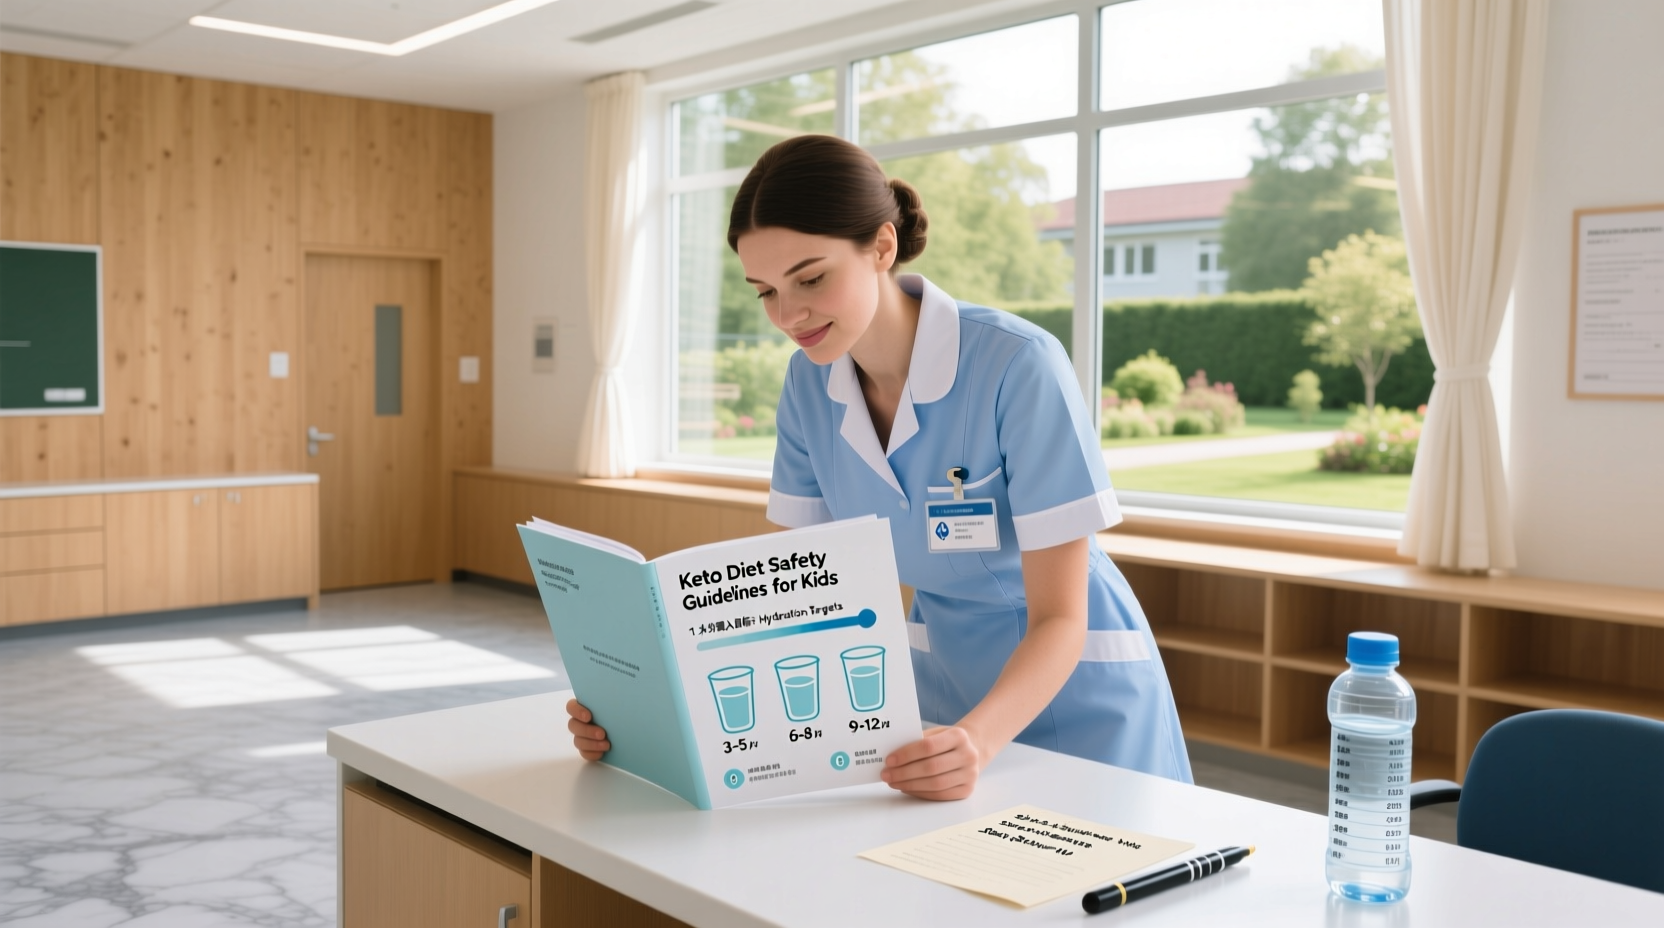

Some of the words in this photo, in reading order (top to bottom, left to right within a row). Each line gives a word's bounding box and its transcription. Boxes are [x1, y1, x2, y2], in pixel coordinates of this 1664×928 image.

[679, 570, 722, 590] Keto
[726, 560, 765, 580] Diet
[768, 551, 826, 572] Safety
[682, 584, 768, 610] Guidelines
[772, 577, 798, 594] for
[801, 569, 839, 589] Kids
[849, 717, 880, 733] 9-12
[789, 727, 812, 742] 6-8
[722, 738, 748, 754] 3-5
